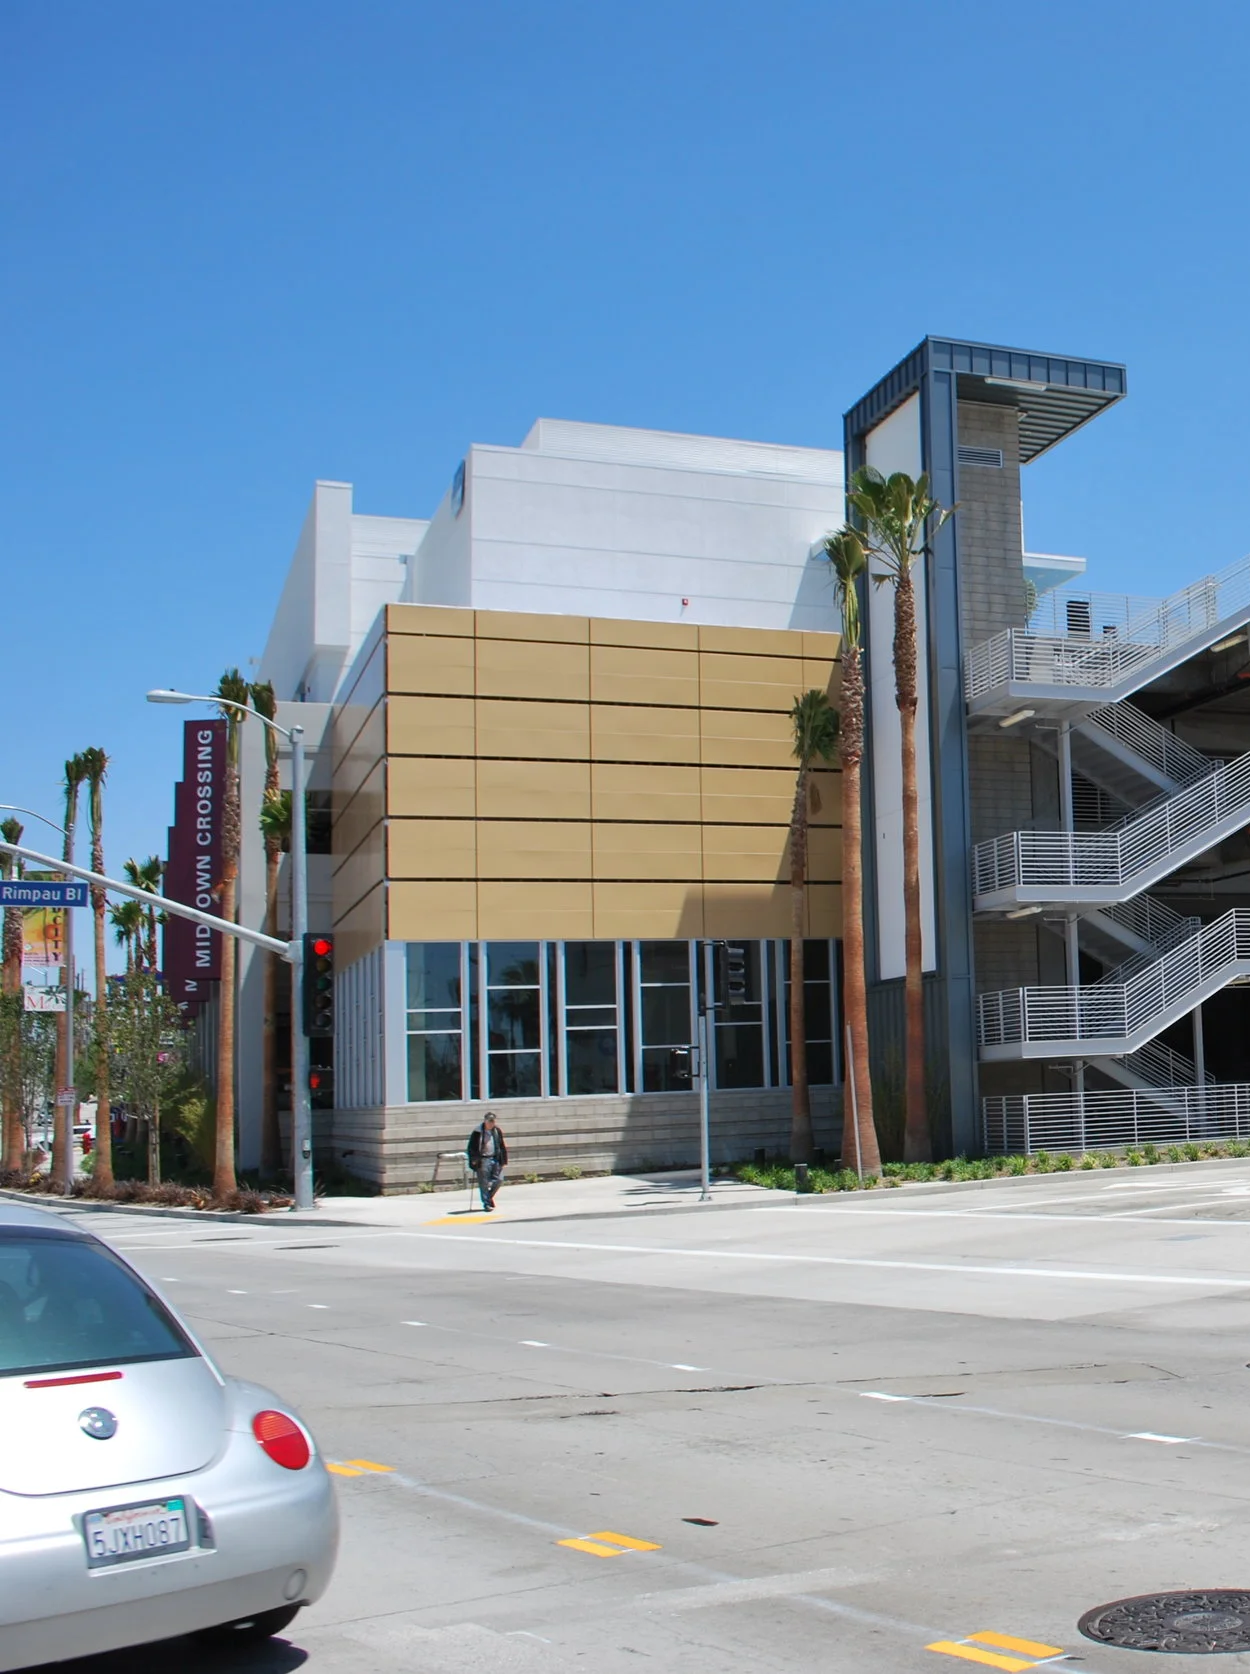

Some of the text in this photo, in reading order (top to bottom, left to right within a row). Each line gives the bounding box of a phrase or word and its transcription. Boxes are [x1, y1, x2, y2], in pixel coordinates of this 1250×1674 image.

[196, 729, 213, 967] MIDOWN CROSSING
[2, 886, 82, 902] Rimpau Bl
[93, 1517, 181, 1556] 5JXH087
